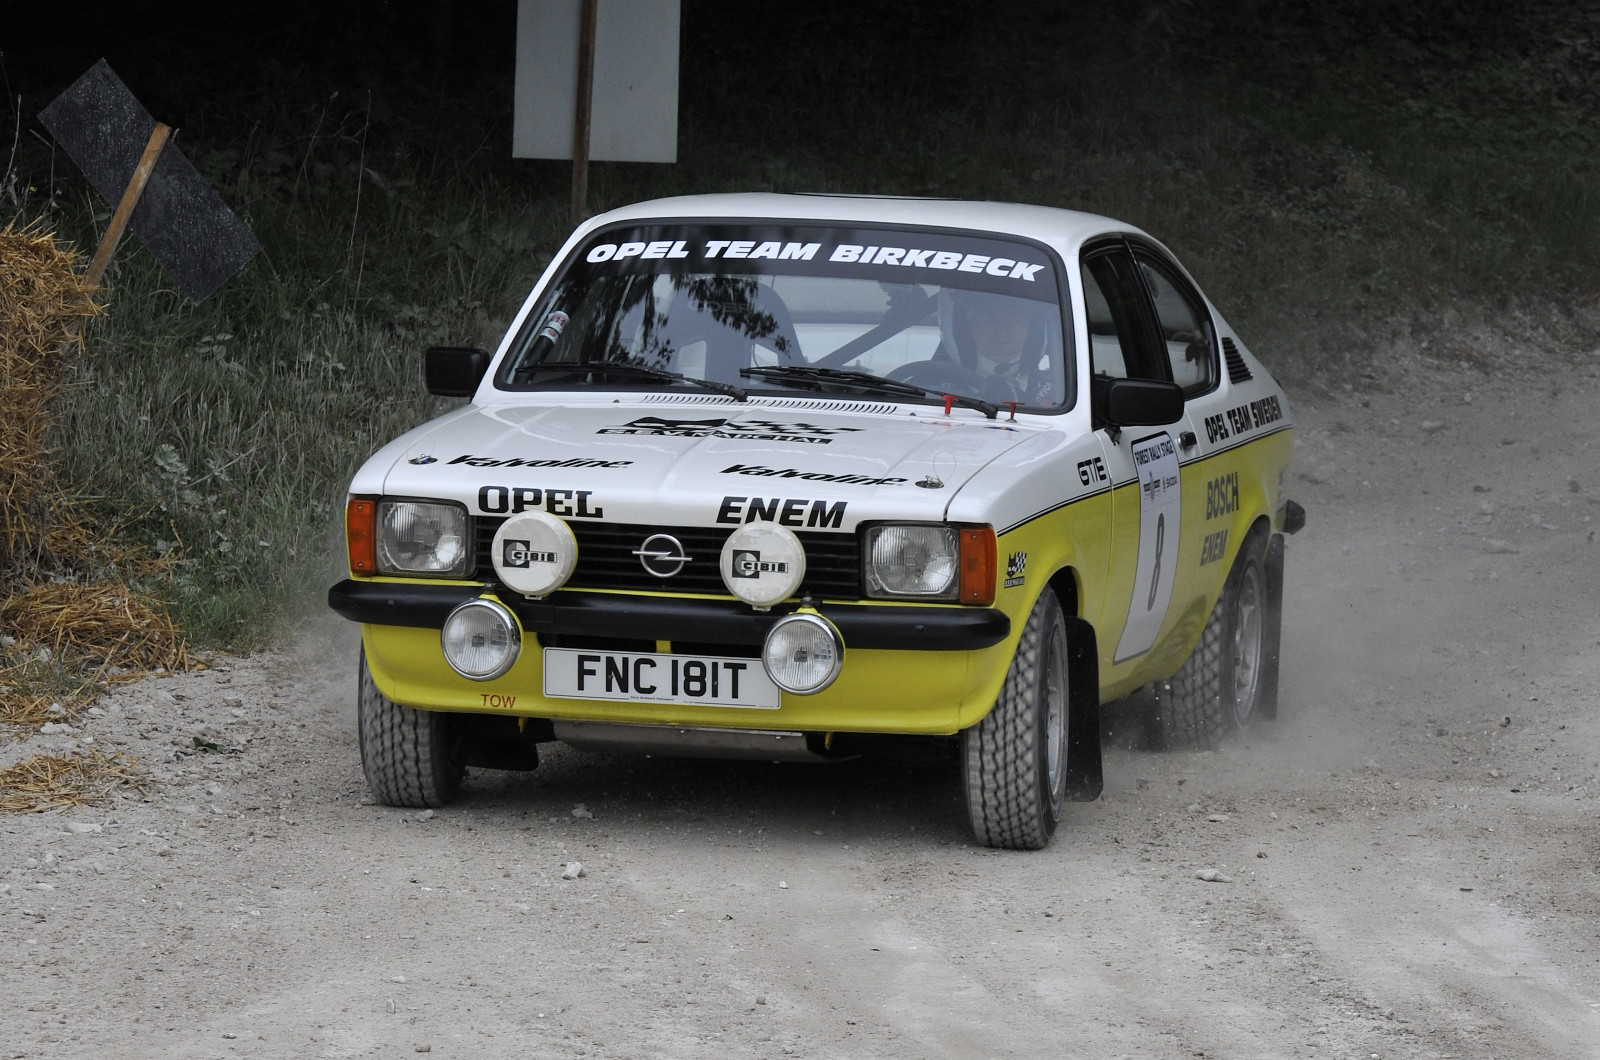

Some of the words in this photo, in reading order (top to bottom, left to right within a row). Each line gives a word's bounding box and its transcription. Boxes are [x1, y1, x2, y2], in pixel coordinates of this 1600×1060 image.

[586, 240, 690, 263] OPEL
[704, 240, 822, 261] TEAM
[828, 244, 1046, 282] BIRKBECK
[1204, 413, 1230, 444] OPEL
[1226, 404, 1254, 436] TEAM
[1250, 394, 1283, 428] SWEDEN
[446, 454, 634, 468] Valvoline
[719, 464, 909, 486] Valvoline
[478, 485, 603, 519] OPEL
[716, 496, 848, 530] ENEM
[1206, 471, 1239, 520] BOSCH
[1147, 512, 1164, 612] 8
[1200, 528, 1229, 567] ENEM
[577, 654, 657, 695] FNC
[671, 659, 747, 699] 181T
[481, 694, 516, 709] TOW
